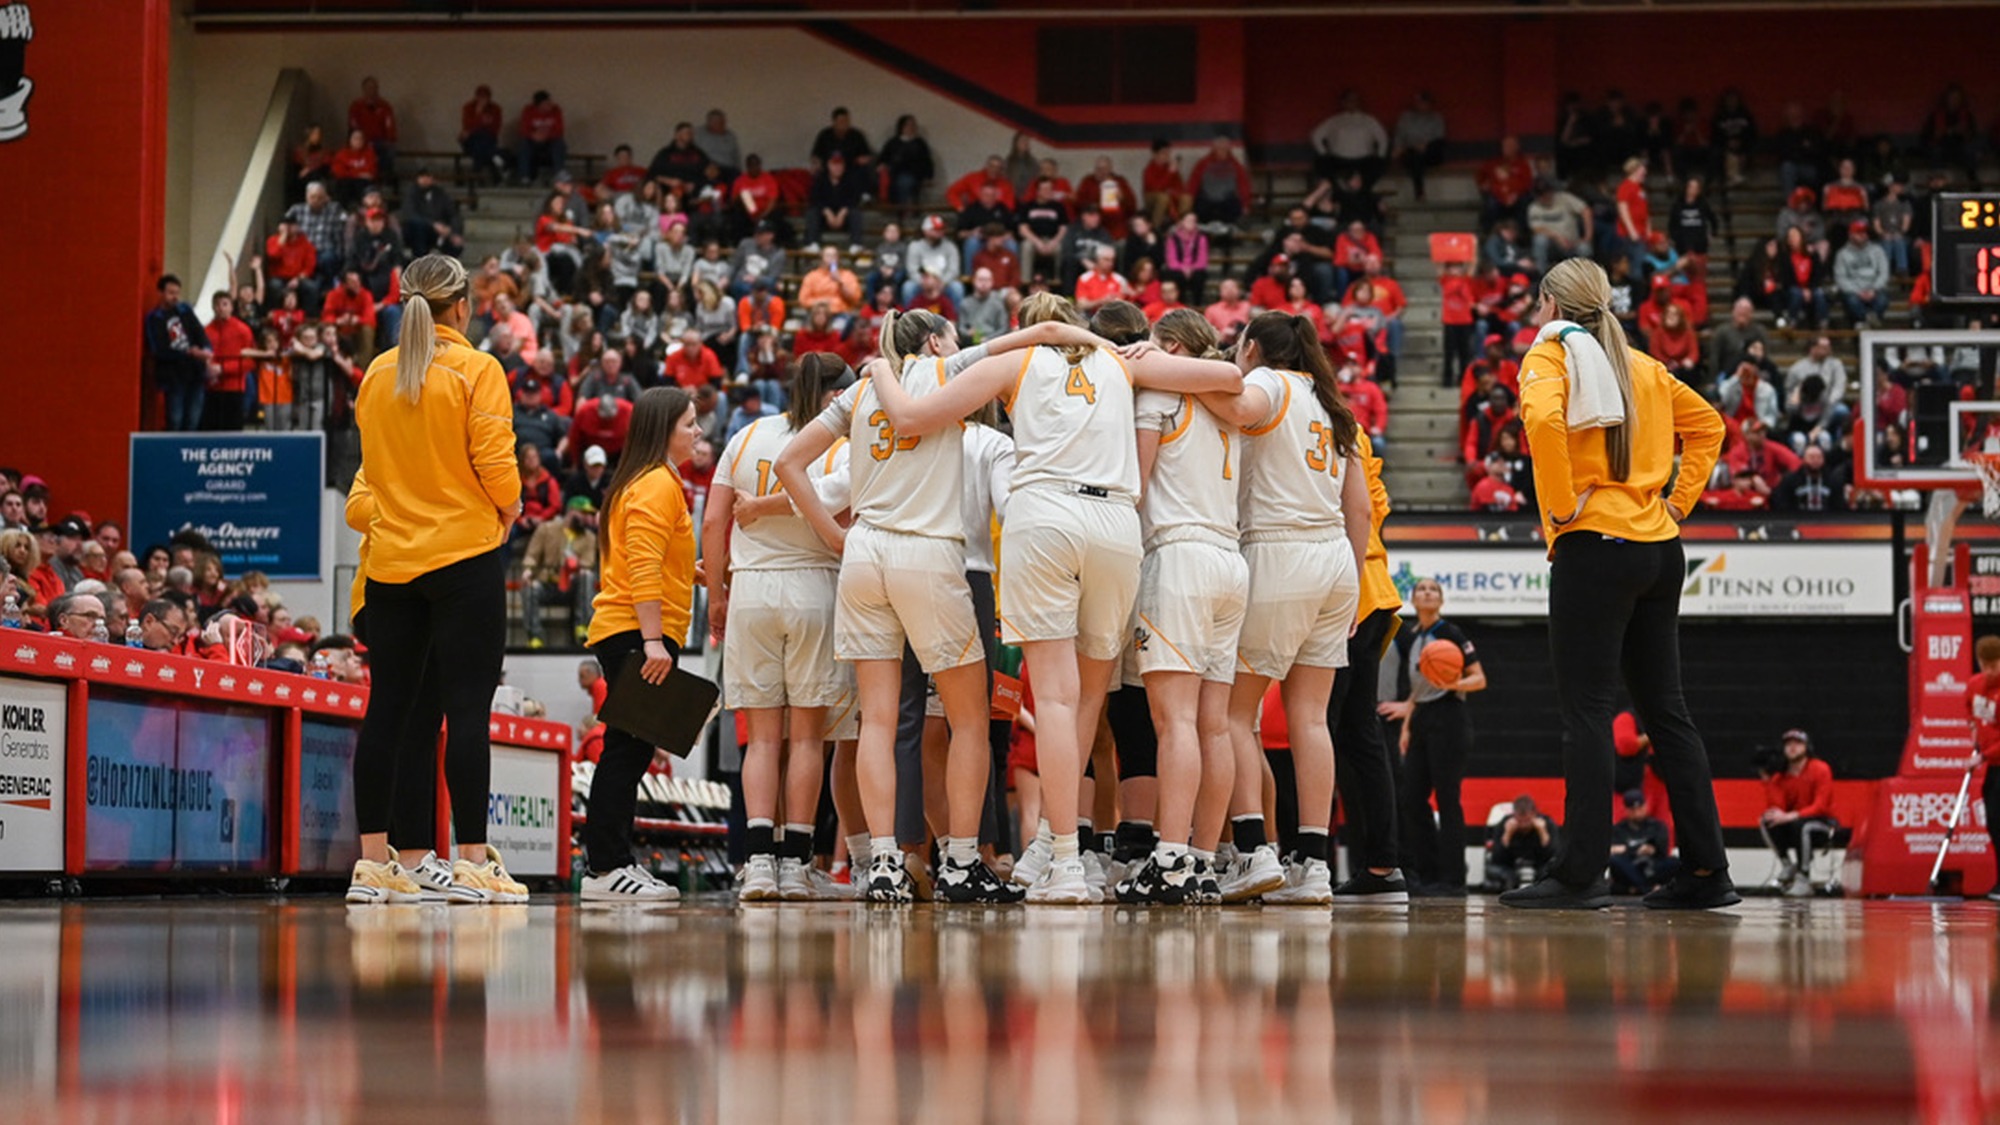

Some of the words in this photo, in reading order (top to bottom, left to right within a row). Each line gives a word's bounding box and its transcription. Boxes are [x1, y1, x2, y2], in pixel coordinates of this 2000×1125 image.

[1961, 200, 2000, 229] 2:
[1065, 364, 1096, 405] 4
[869, 409, 922, 462] 3
[1305, 420, 1339, 479] 31
[181, 448, 208, 462] THE
[210, 448, 273, 462] GRIFFITH
[197, 462, 255, 476] AGENCY
[168, 521, 281, 539] Ato-Owners
[1434, 571, 1551, 591] MERCYH
[1707, 577, 1774, 597] PENN
[1782, 575, 1856, 597] OHIO
[1, 704, 47, 733] KOHLER
[1, 732, 49, 760] Generators
[0, 774, 52, 797] GENERAC
[488, 793, 555, 830] RCYHEALTH
